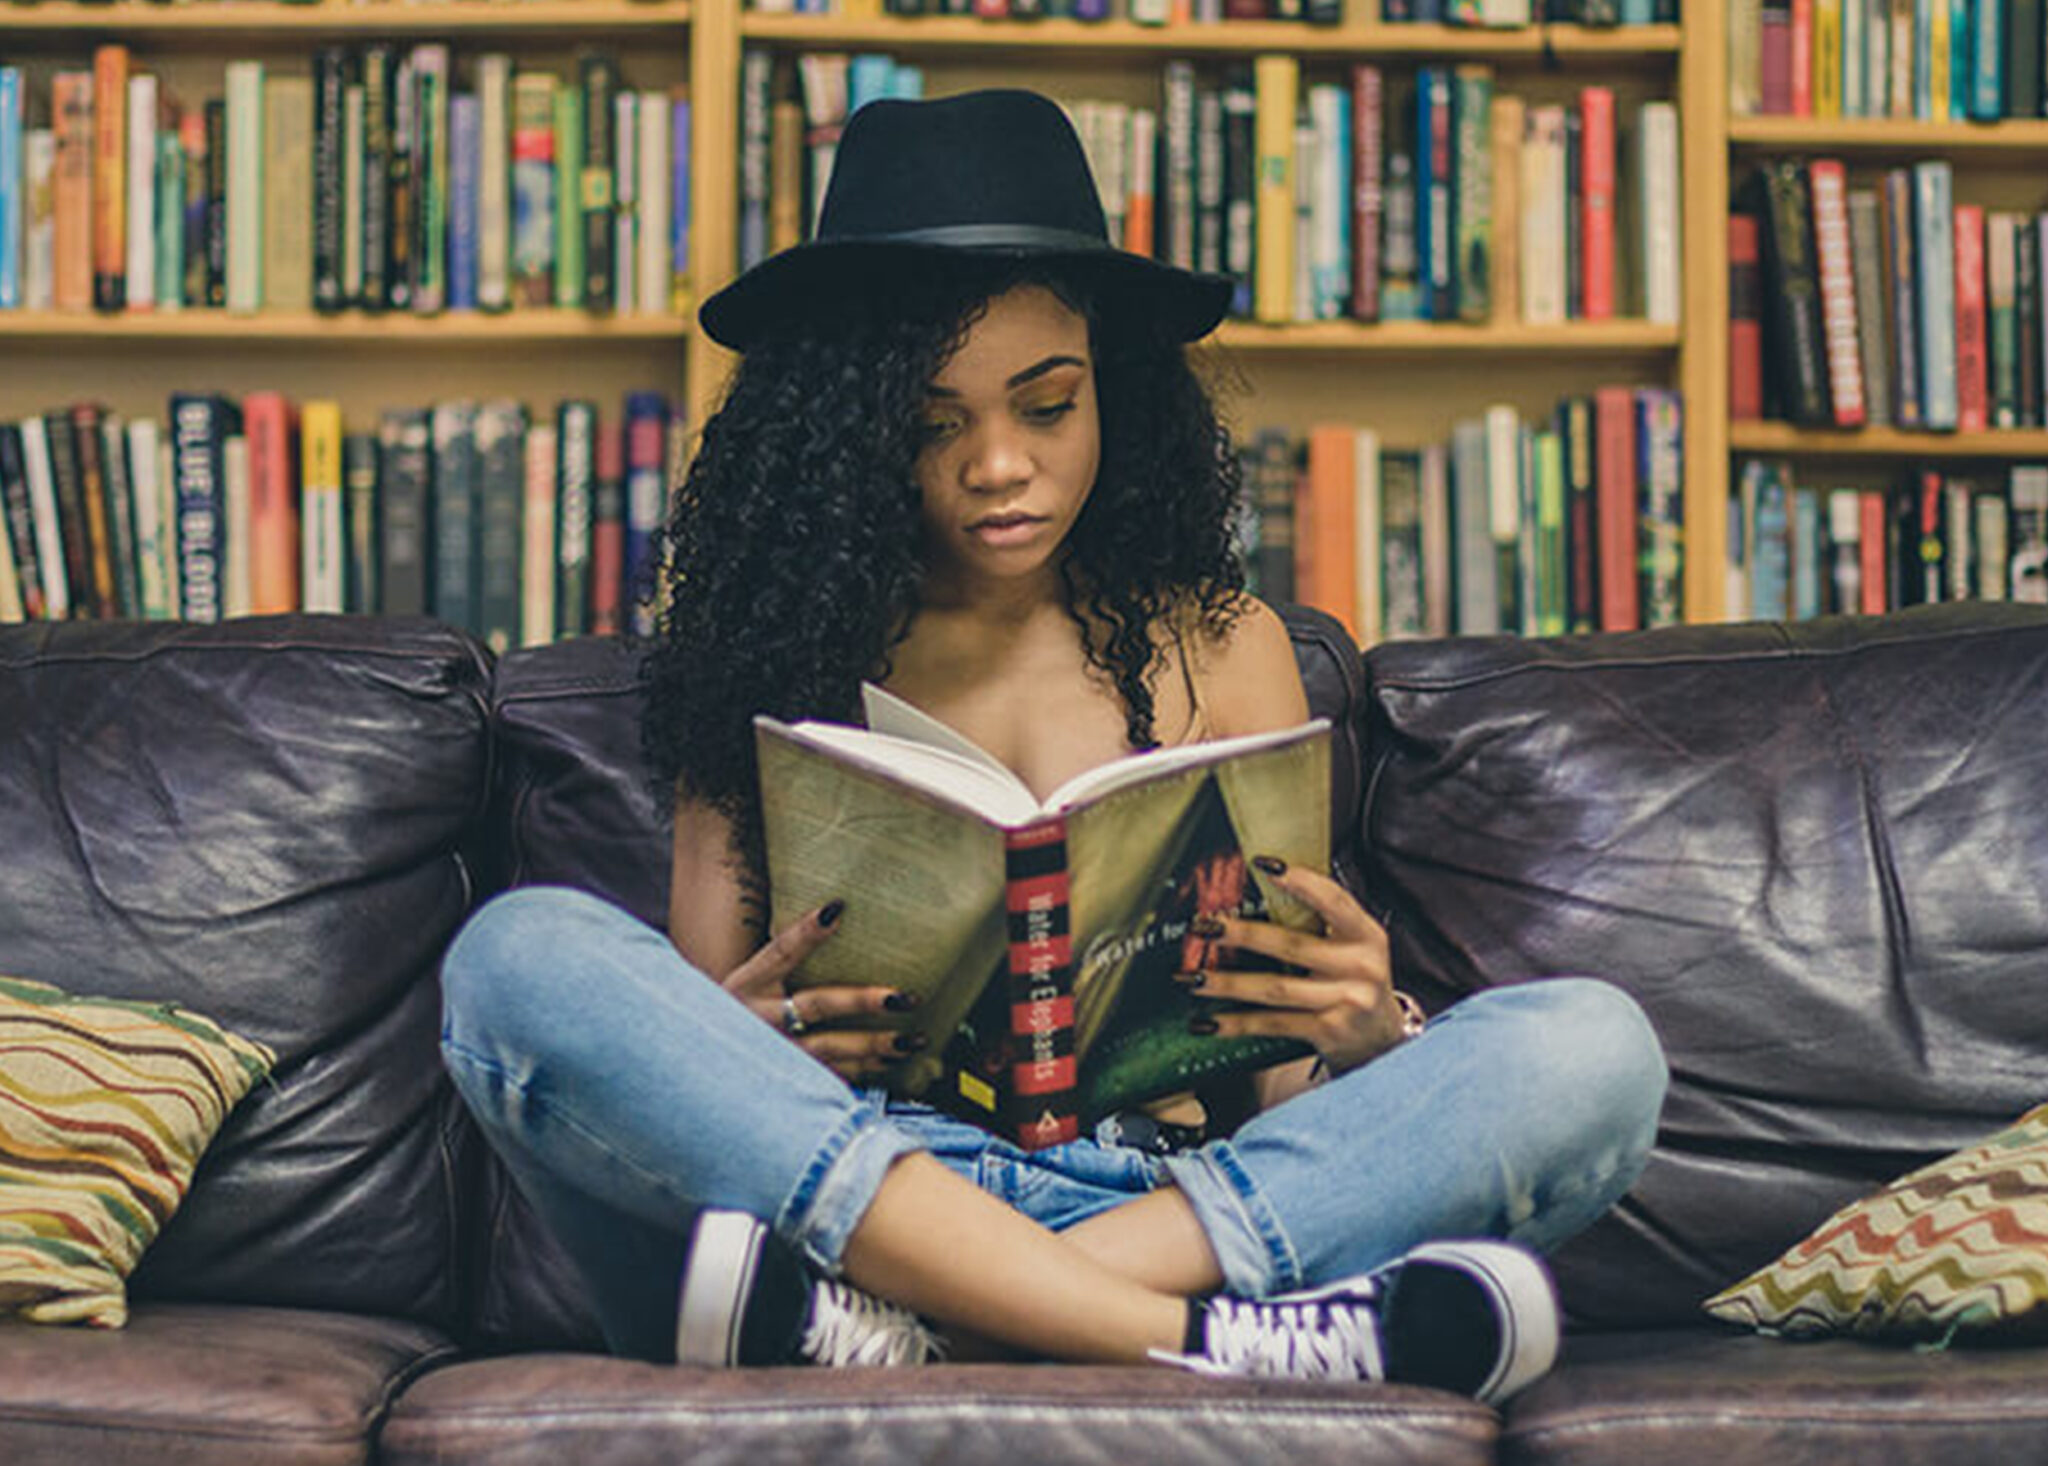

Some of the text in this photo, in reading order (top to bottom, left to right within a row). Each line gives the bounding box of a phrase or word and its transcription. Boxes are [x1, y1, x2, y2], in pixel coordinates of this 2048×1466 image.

[177, 402, 213, 498] BLUE
[1028, 892, 1060, 1081] Water for Elephants
